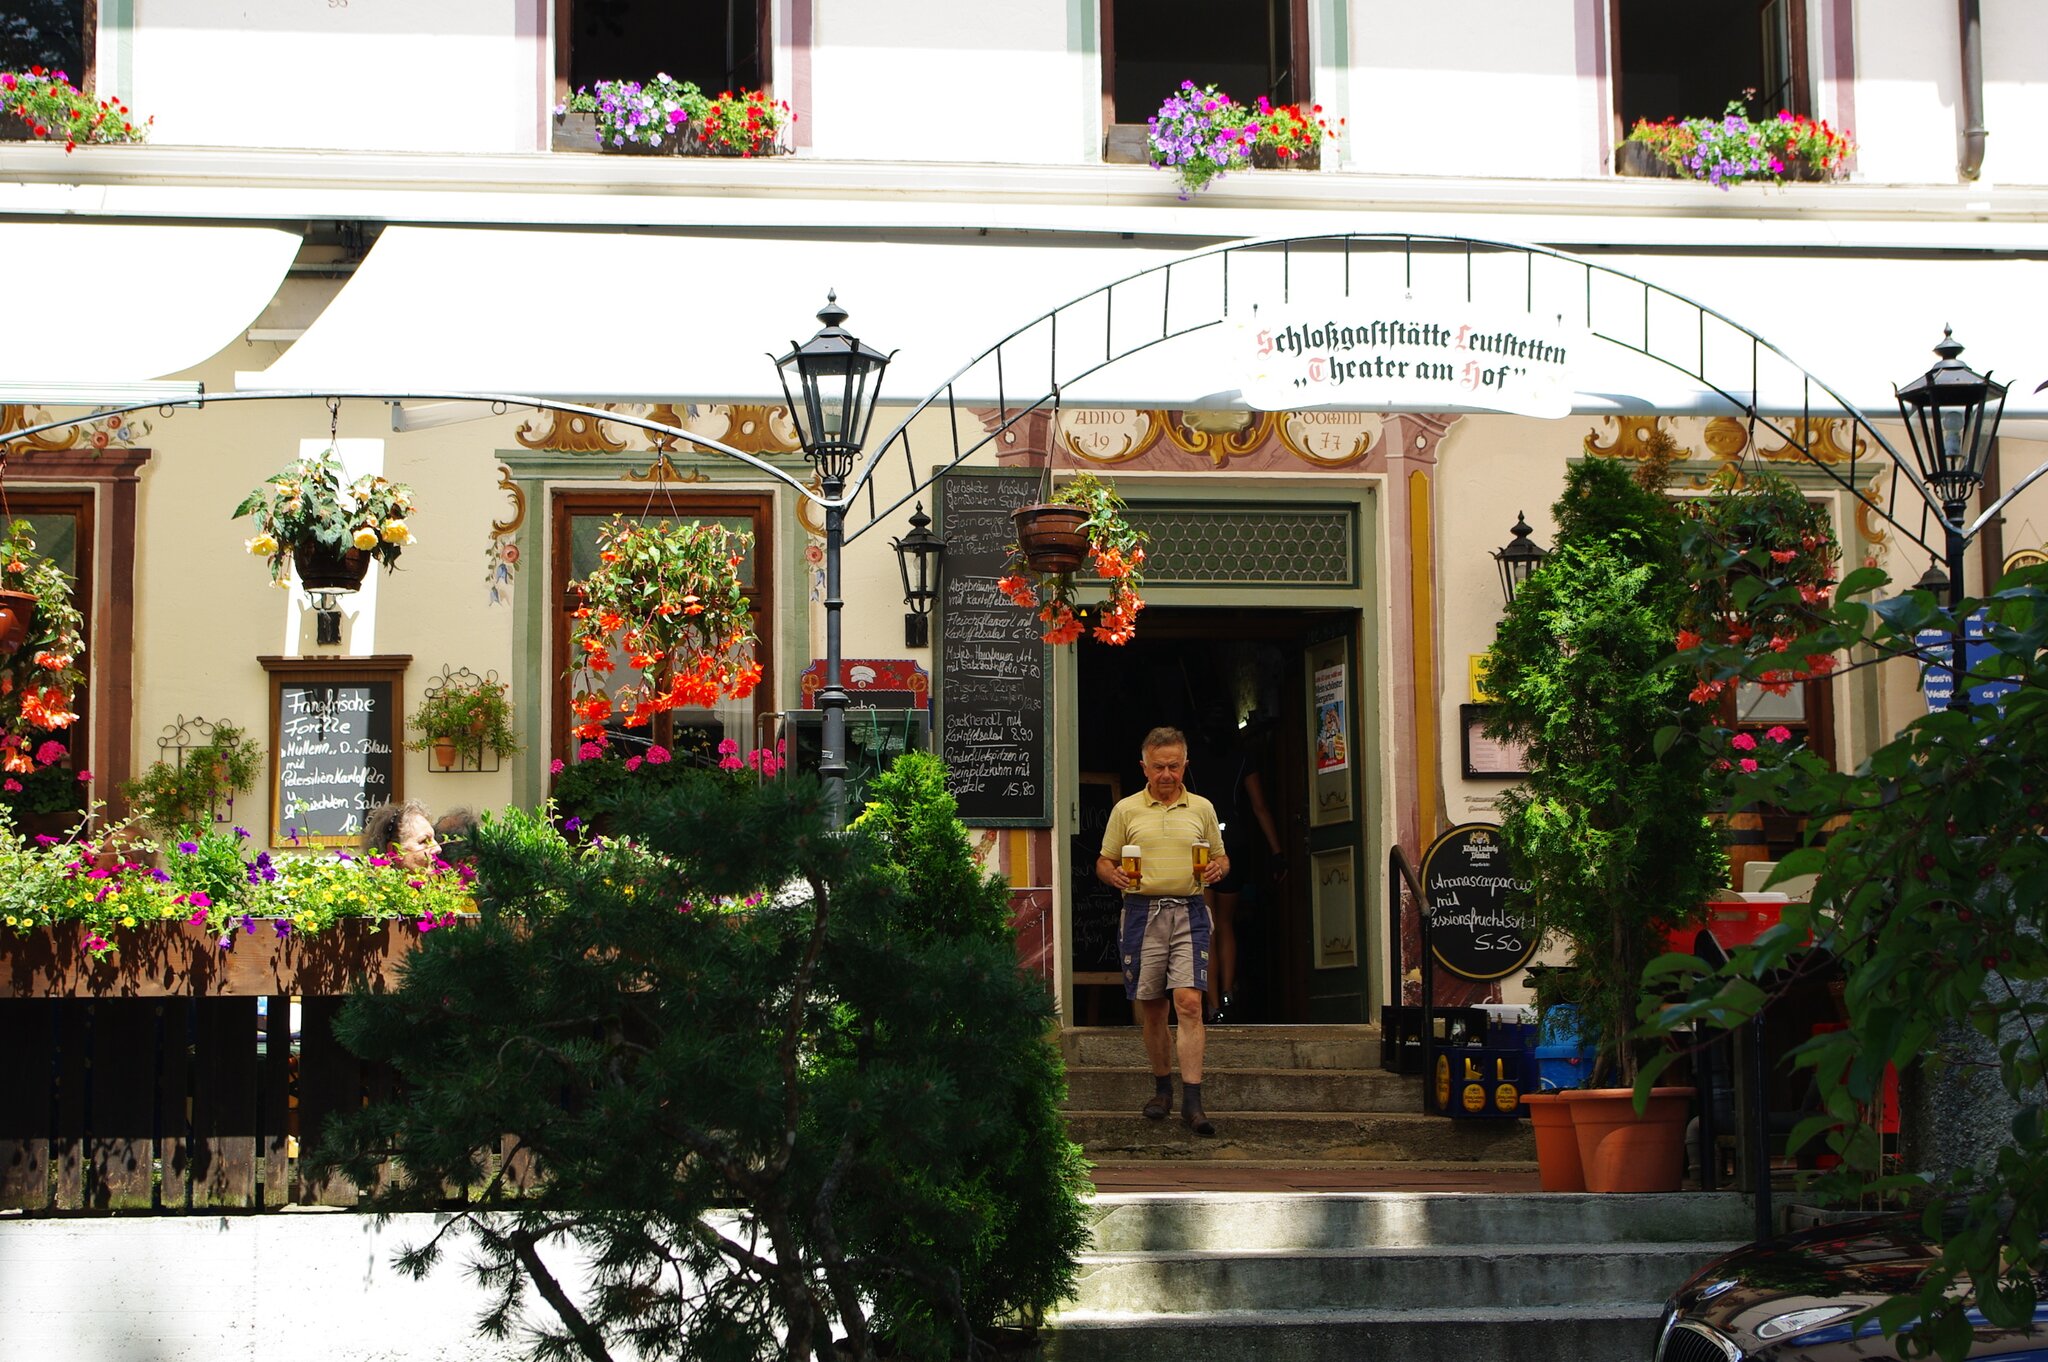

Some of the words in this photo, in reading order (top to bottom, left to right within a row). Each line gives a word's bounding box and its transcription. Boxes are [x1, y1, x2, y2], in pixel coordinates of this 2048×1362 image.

[1257, 320, 1452, 359] Schloßgaststätte
[1455, 323, 1567, 365] Leutstetten
[1415, 362, 1454, 382] am
[1088, 432, 1110, 450] 19
[1319, 432, 1342, 451] 77
[1017, 611, 1035, 627] mit
[284, 717, 350, 736] Forelle
[1006, 710, 1022, 727] mit
[1018, 747, 1029, 762] in
[1014, 763, 1030, 778] mit
[947, 777, 986, 799] Spätzle
[1436, 890, 1461, 908] mit
